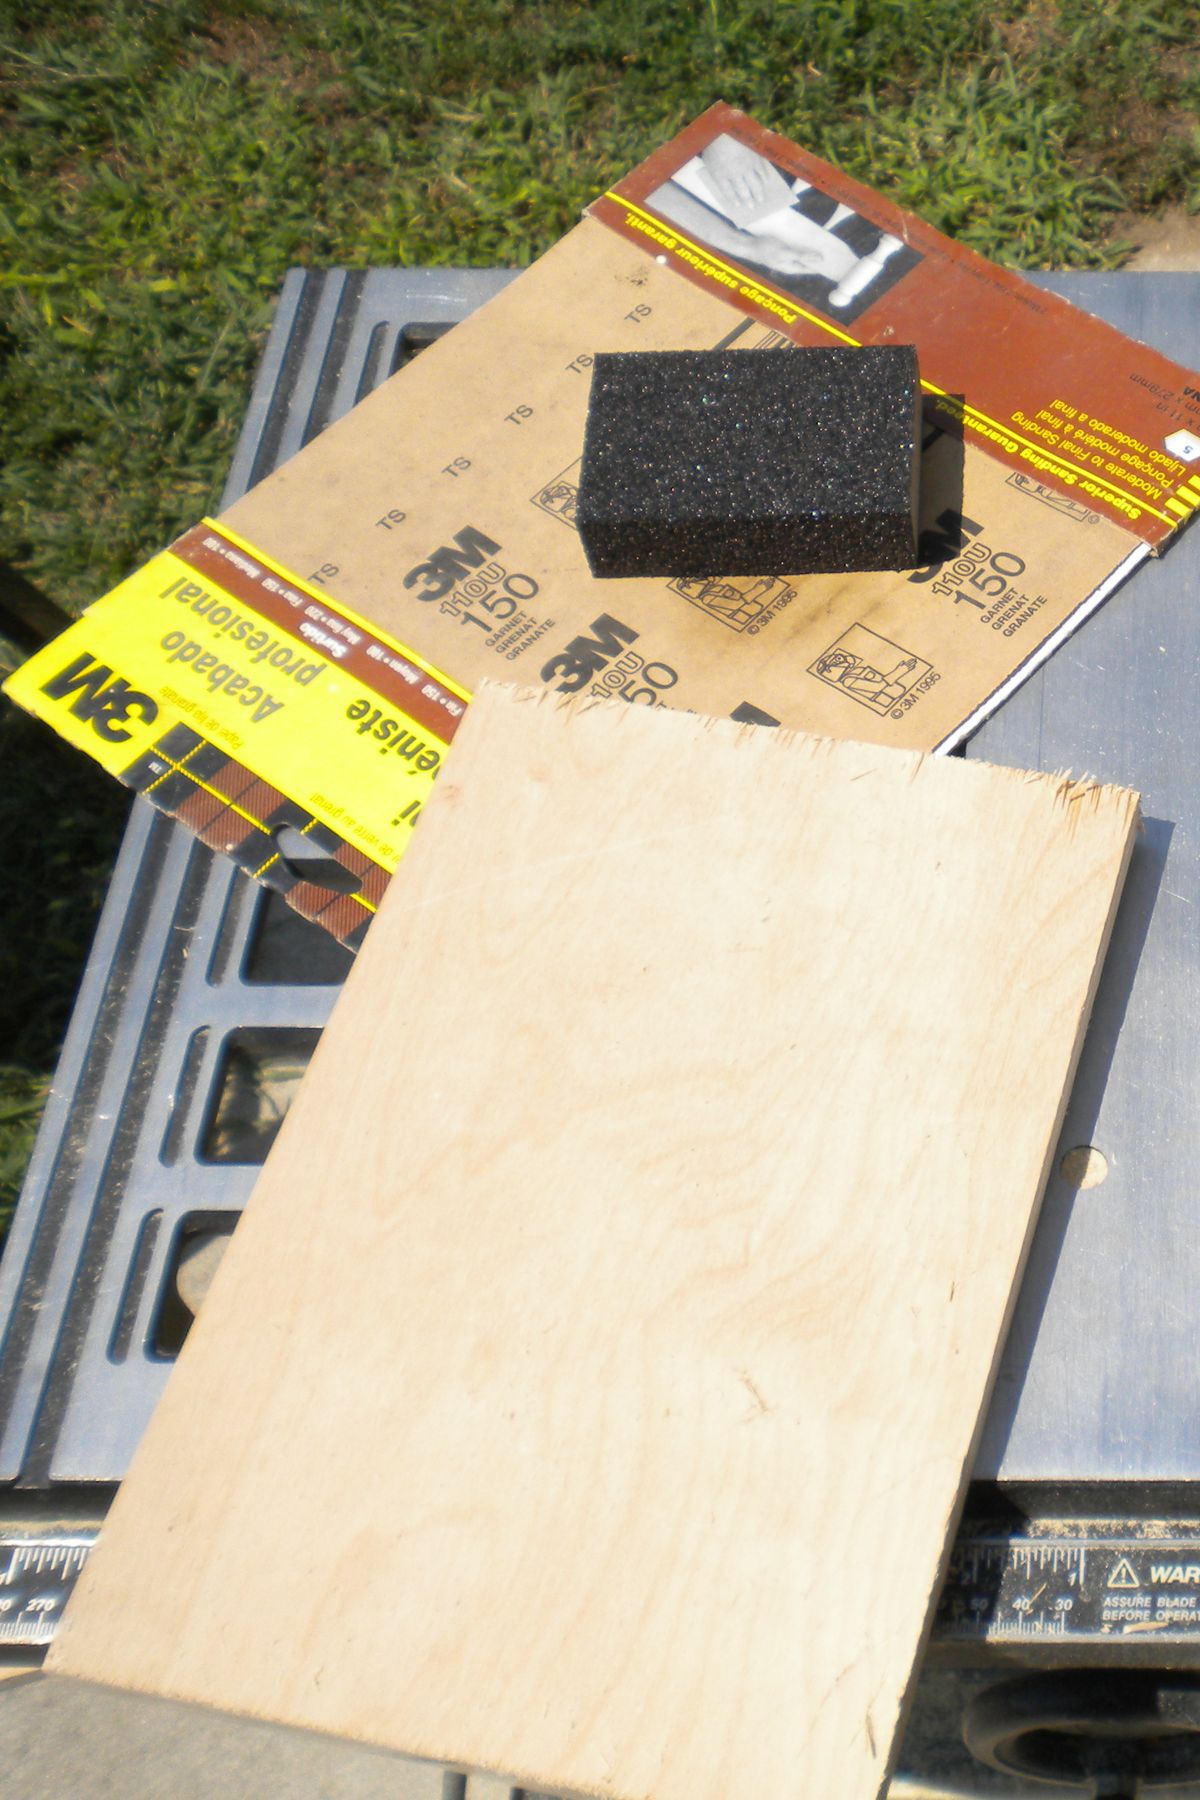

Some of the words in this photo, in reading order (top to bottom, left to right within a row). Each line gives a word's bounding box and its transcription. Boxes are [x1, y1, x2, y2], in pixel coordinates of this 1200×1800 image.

[622, 211, 678, 250] garanti.
[674, 243, 740, 290] supérieur
[624, 300, 652, 324] TS
[737, 283, 798, 325] Ponçage
[565, 351, 593, 375] TS
[1128, 372, 1173, 402] 279mm
[504, 401, 534, 427] TS
[1035, 408, 1064, 430] final
[1050, 398, 1077, 419] final
[1077, 412, 1088, 422] a
[1010, 409, 1061, 445] Sanding
[1063, 422, 1074, 435] à
[1072, 428, 1119, 460] modéré
[1087, 417, 1148, 456] moderado
[442, 453, 471, 479] TS
[1019, 447, 1079, 487] Sanding
[1059, 438, 1091, 461] Final
[1089, 453, 1105, 468] to
[1147, 448, 1186, 476] Lijado
[1182, 444, 1193, 455] 5
[1103, 461, 1162, 500] Moderate
[1118, 450, 1174, 489] Ponçage
[1077, 478, 1142, 520] Superior
[375, 506, 406, 533] TS
[308, 560, 340, 588] TS
[400, 524, 502, 603] 3M
[930, 539, 993, 595] 110U
[950, 546, 1028, 610] 150
[437, 560, 507, 618] 110U
[458, 566, 541, 634] 150
[773, 587, 798, 612] 1995
[978, 586, 1019, 625] GARNET
[484, 609, 528, 648] GARNET
[989, 592, 1030, 631] GRENAT
[1000, 592, 1047, 638] GRANATE
[158, 575, 327, 694] profesional
[296, 620, 347, 659] Surtido
[494, 615, 538, 655] GRENAT
[504, 616, 555, 662] GRANATE
[536, 612, 639, 699] 3M
[156, 627, 284, 725] Acabado
[420, 682, 441, 701] 150
[586, 650, 646, 699] 10U
[616, 657, 681, 707] 50
[914, 668, 941, 694] 1995
[38, 649, 164, 751] 3M
[157, 683, 195, 714] granate
[442, 699, 462, 717] Fin
[202, 717, 219, 734] de
[216, 724, 244, 749] Papel
[342, 701, 442, 780] éniste
[25, 1598, 55, 1611] 270
[1012, 1599, 1029, 1610] 40
[1055, 1599, 1072, 1610] 30
[1103, 1597, 1151, 1608] ASSURE
[1157, 1597, 1196, 1607] BLADE
[1103, 1610, 1150, 1621] BEFORE
